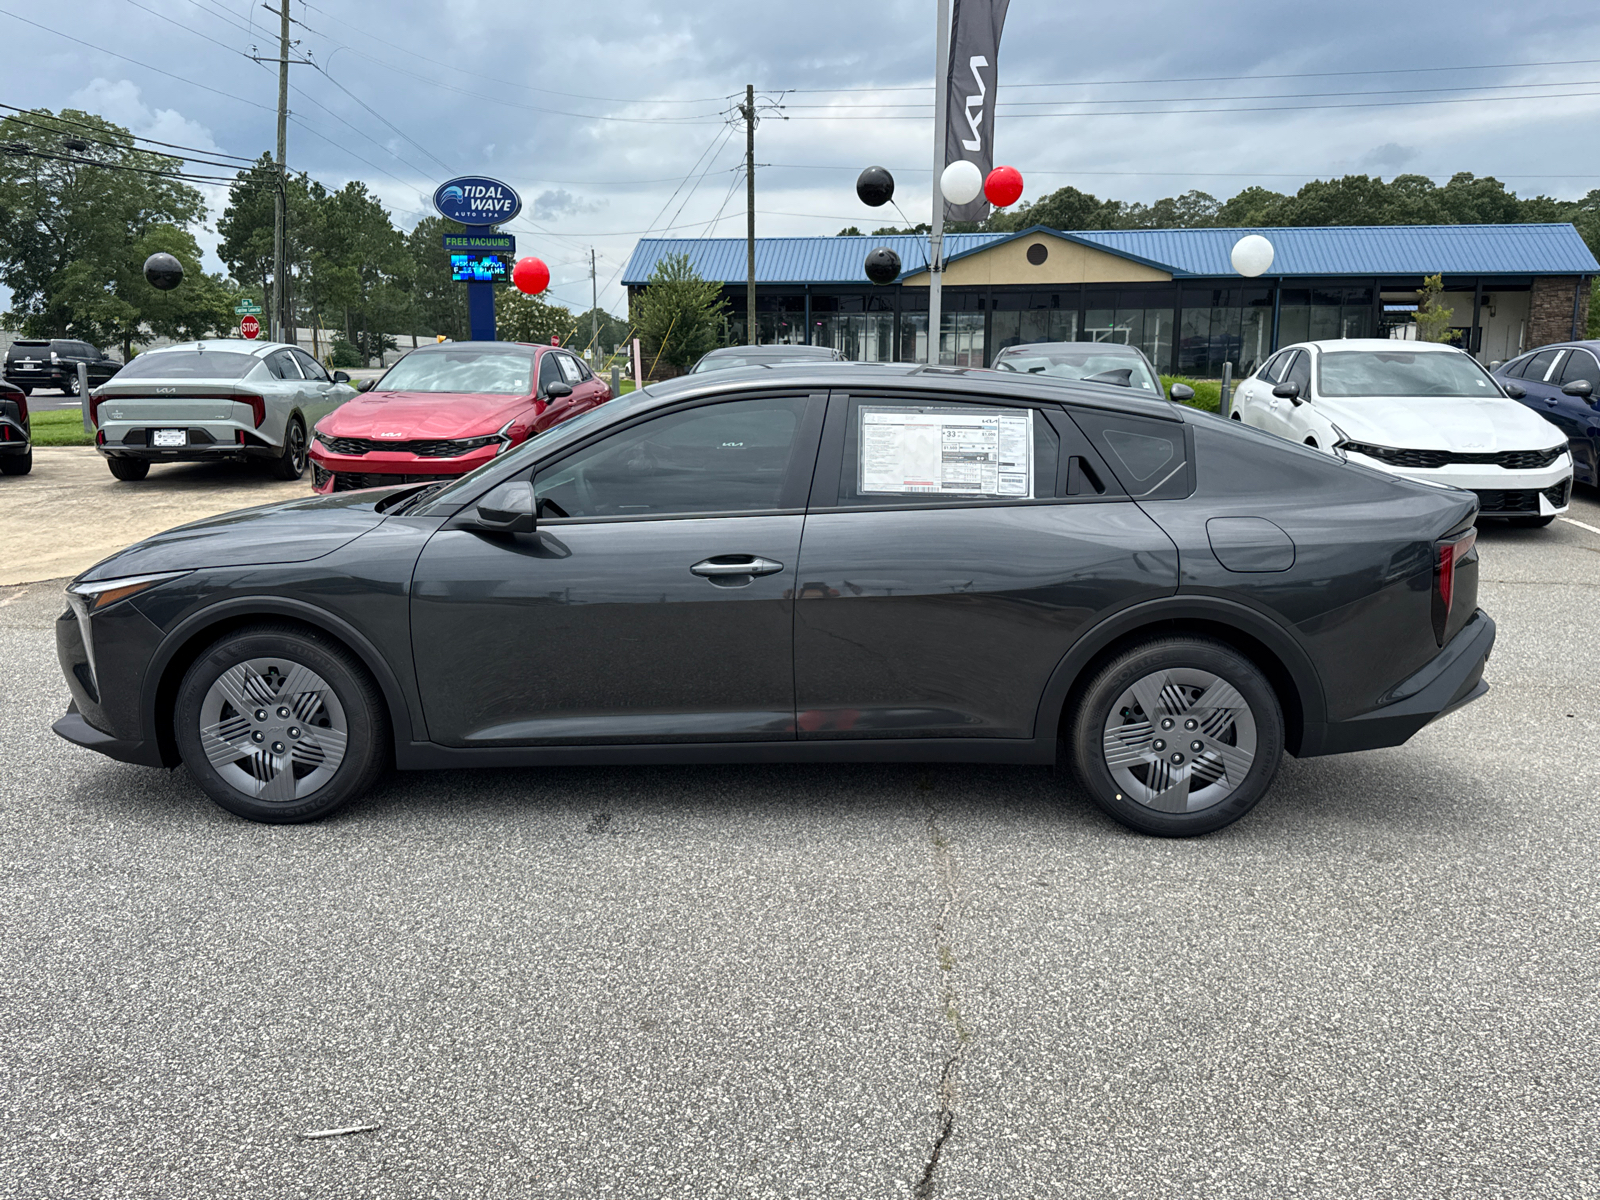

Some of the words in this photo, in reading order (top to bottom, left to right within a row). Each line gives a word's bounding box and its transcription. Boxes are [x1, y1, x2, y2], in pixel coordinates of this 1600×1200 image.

[463, 186, 503, 198] TIDAL
[470, 199, 512, 211] WAVE
[446, 238, 468, 246] FREE
[469, 238, 510, 247] VACUUMS
[242, 322, 258, 332] STOP
[946, 430, 956, 438] 33
[285, 643, 340, 679] KUMHO
[1110, 655, 1163, 689] SOLUS
[284, 789, 337, 817] SOLUS
